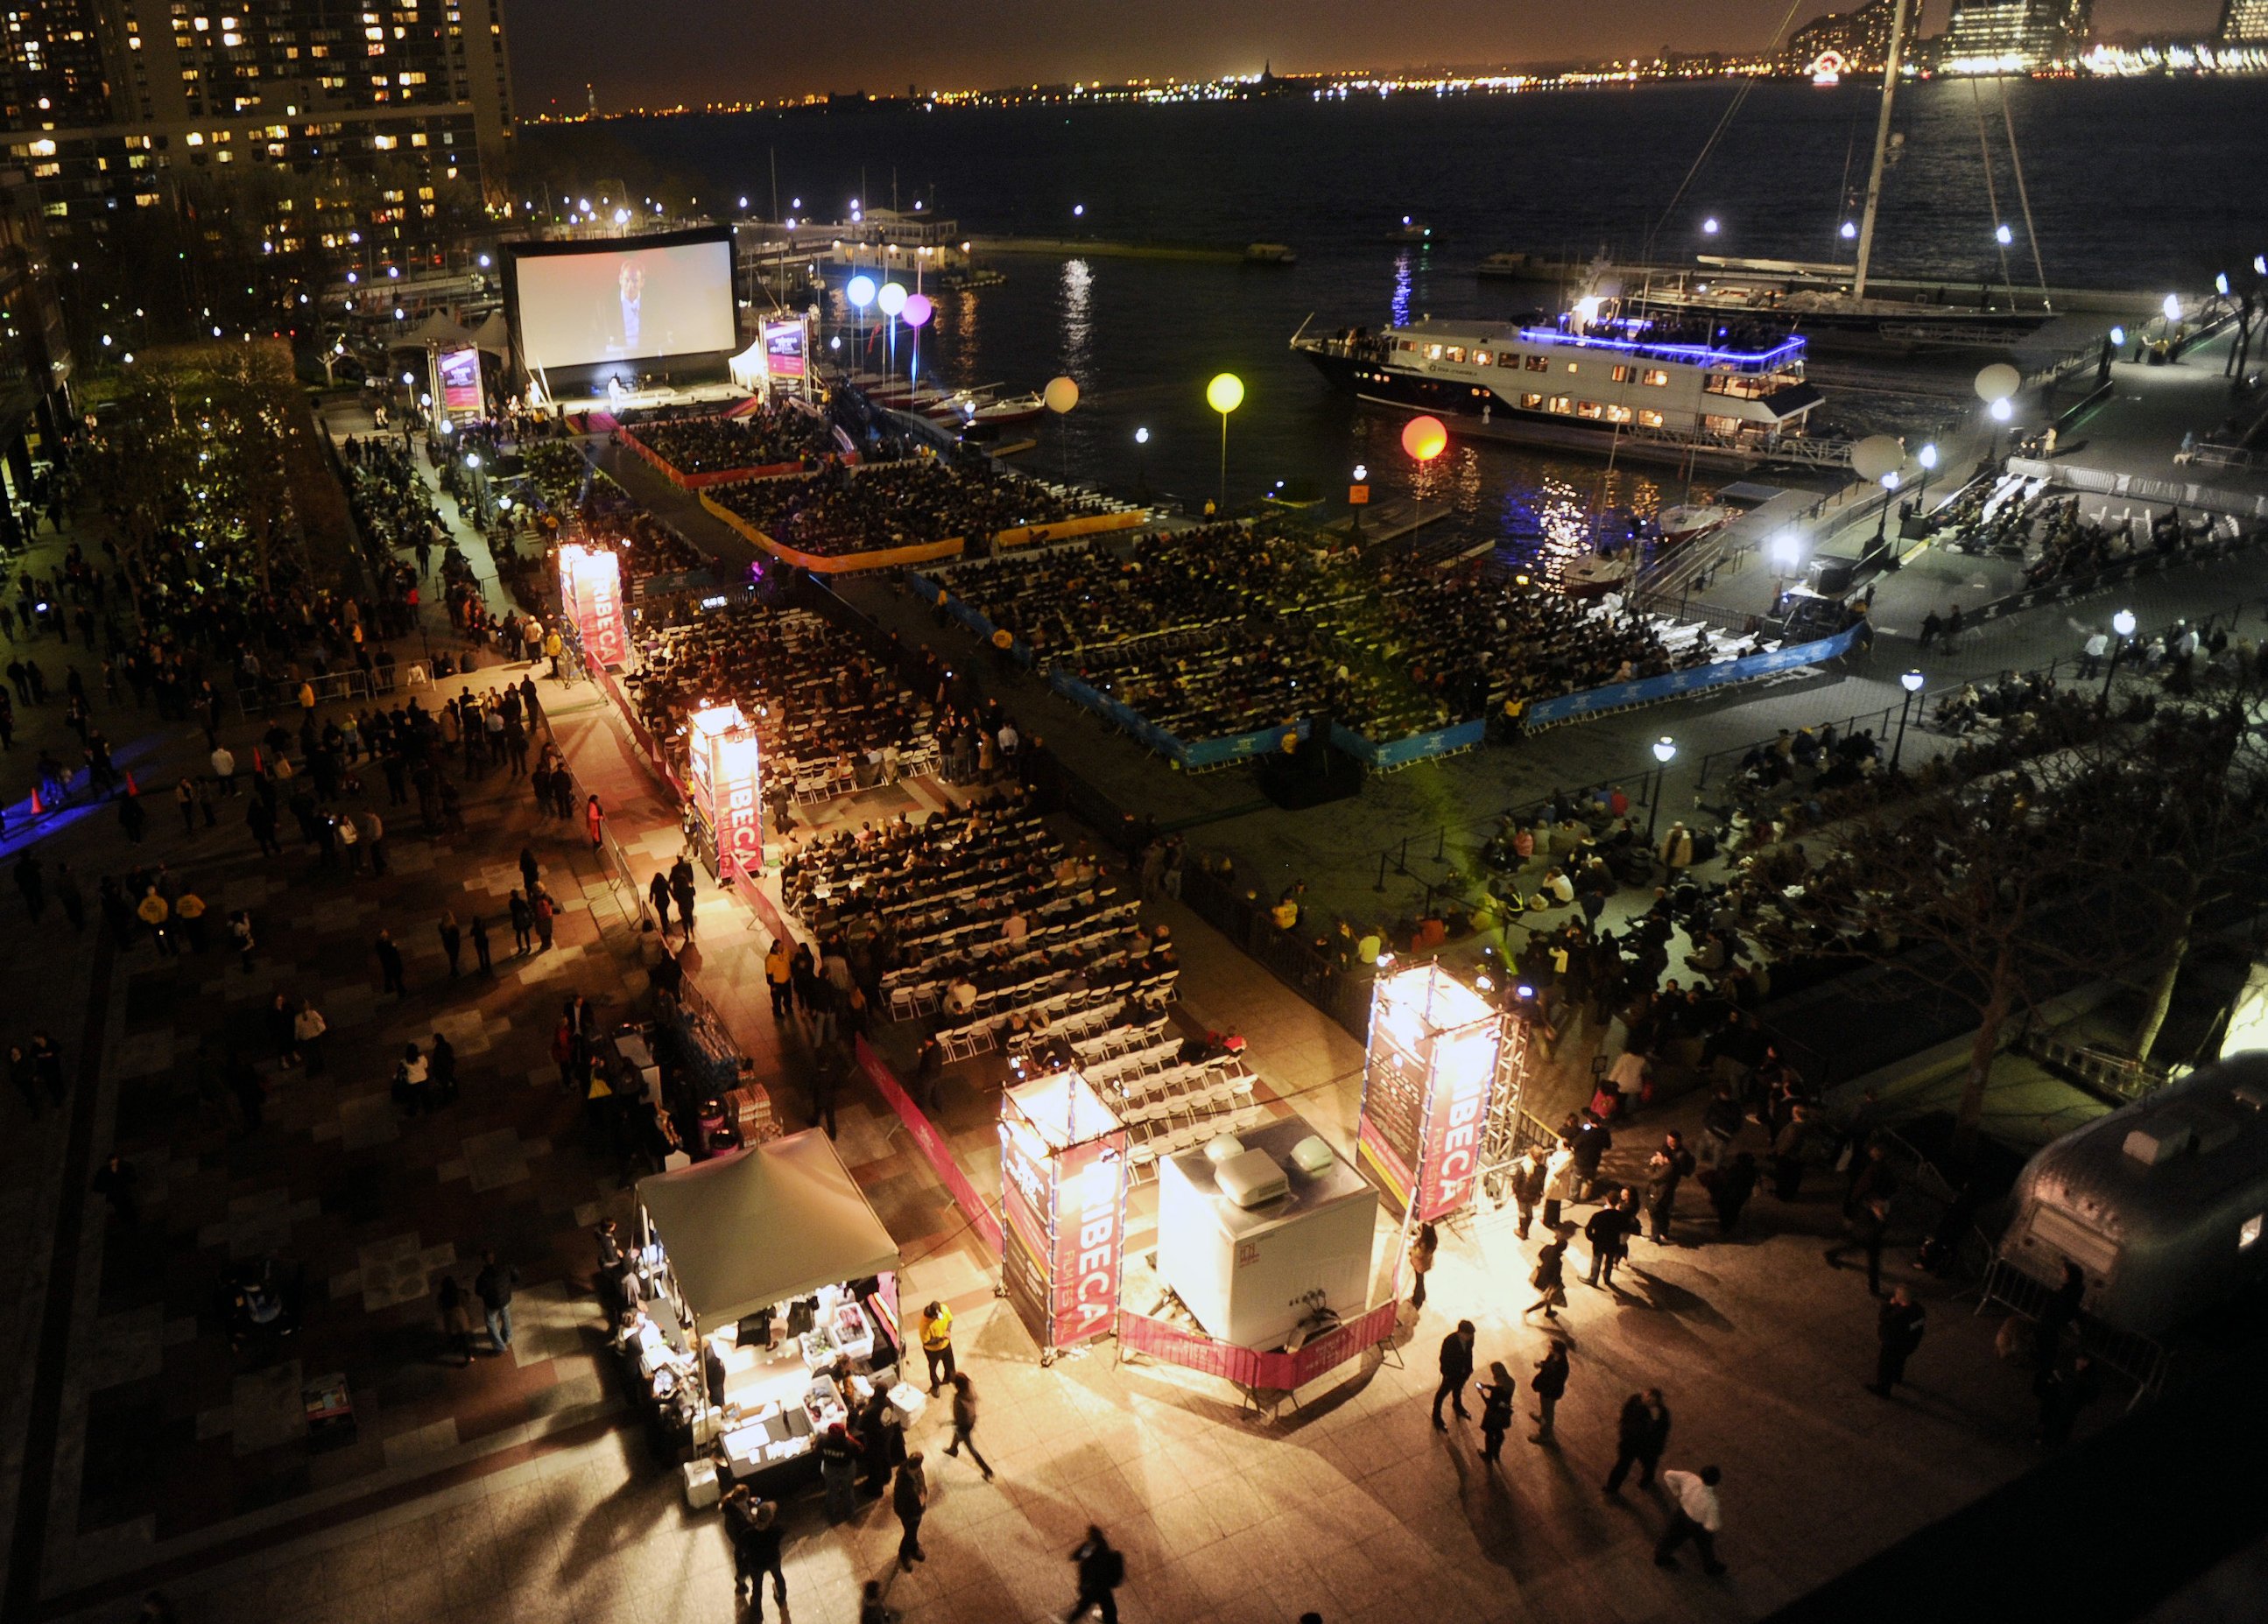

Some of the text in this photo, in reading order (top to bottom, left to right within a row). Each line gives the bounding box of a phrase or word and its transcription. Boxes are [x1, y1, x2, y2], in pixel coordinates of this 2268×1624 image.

[1424, 1128, 1442, 1213] FILM FESTIVAL
[1062, 1250, 1074, 1280] FILM
